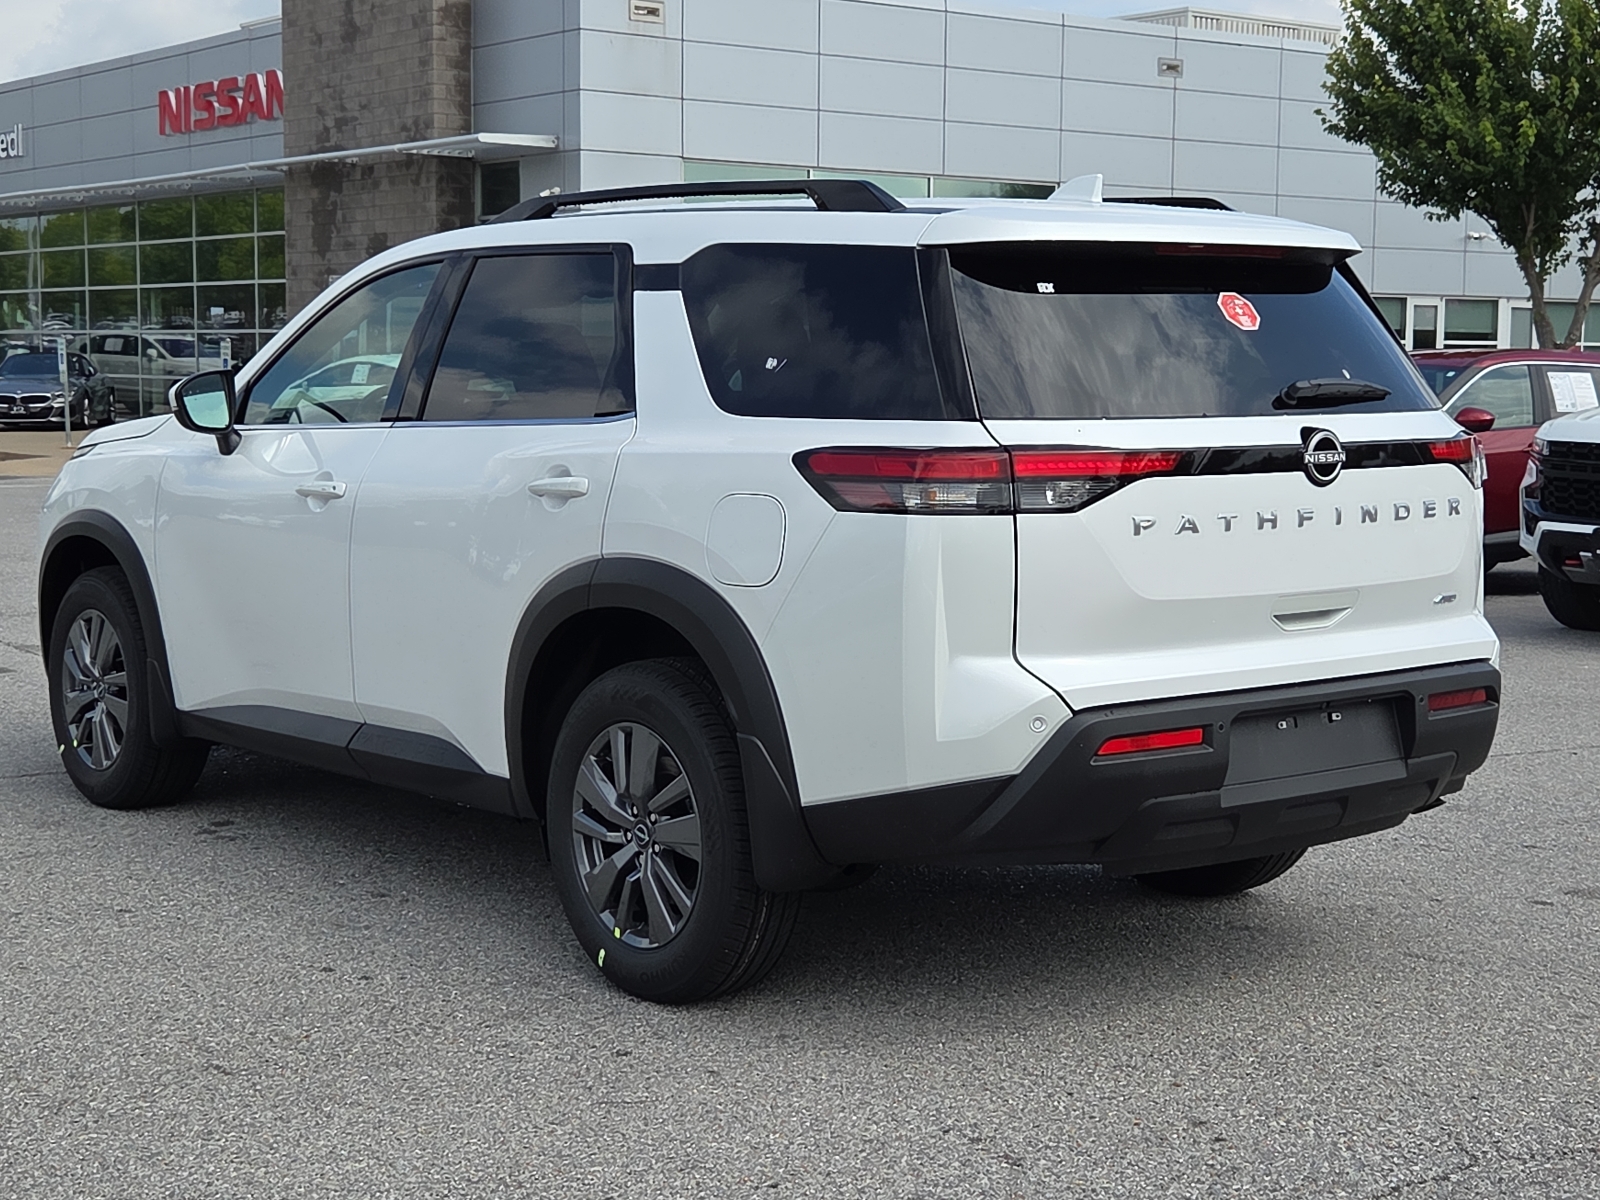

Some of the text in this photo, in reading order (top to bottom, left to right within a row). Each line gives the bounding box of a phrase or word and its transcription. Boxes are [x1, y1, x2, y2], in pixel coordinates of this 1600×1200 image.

[158, 68, 284, 136] NISSAN
[1304, 452, 1346, 464] NISSAN
[1131, 497, 1461, 537] PATHFINDER
